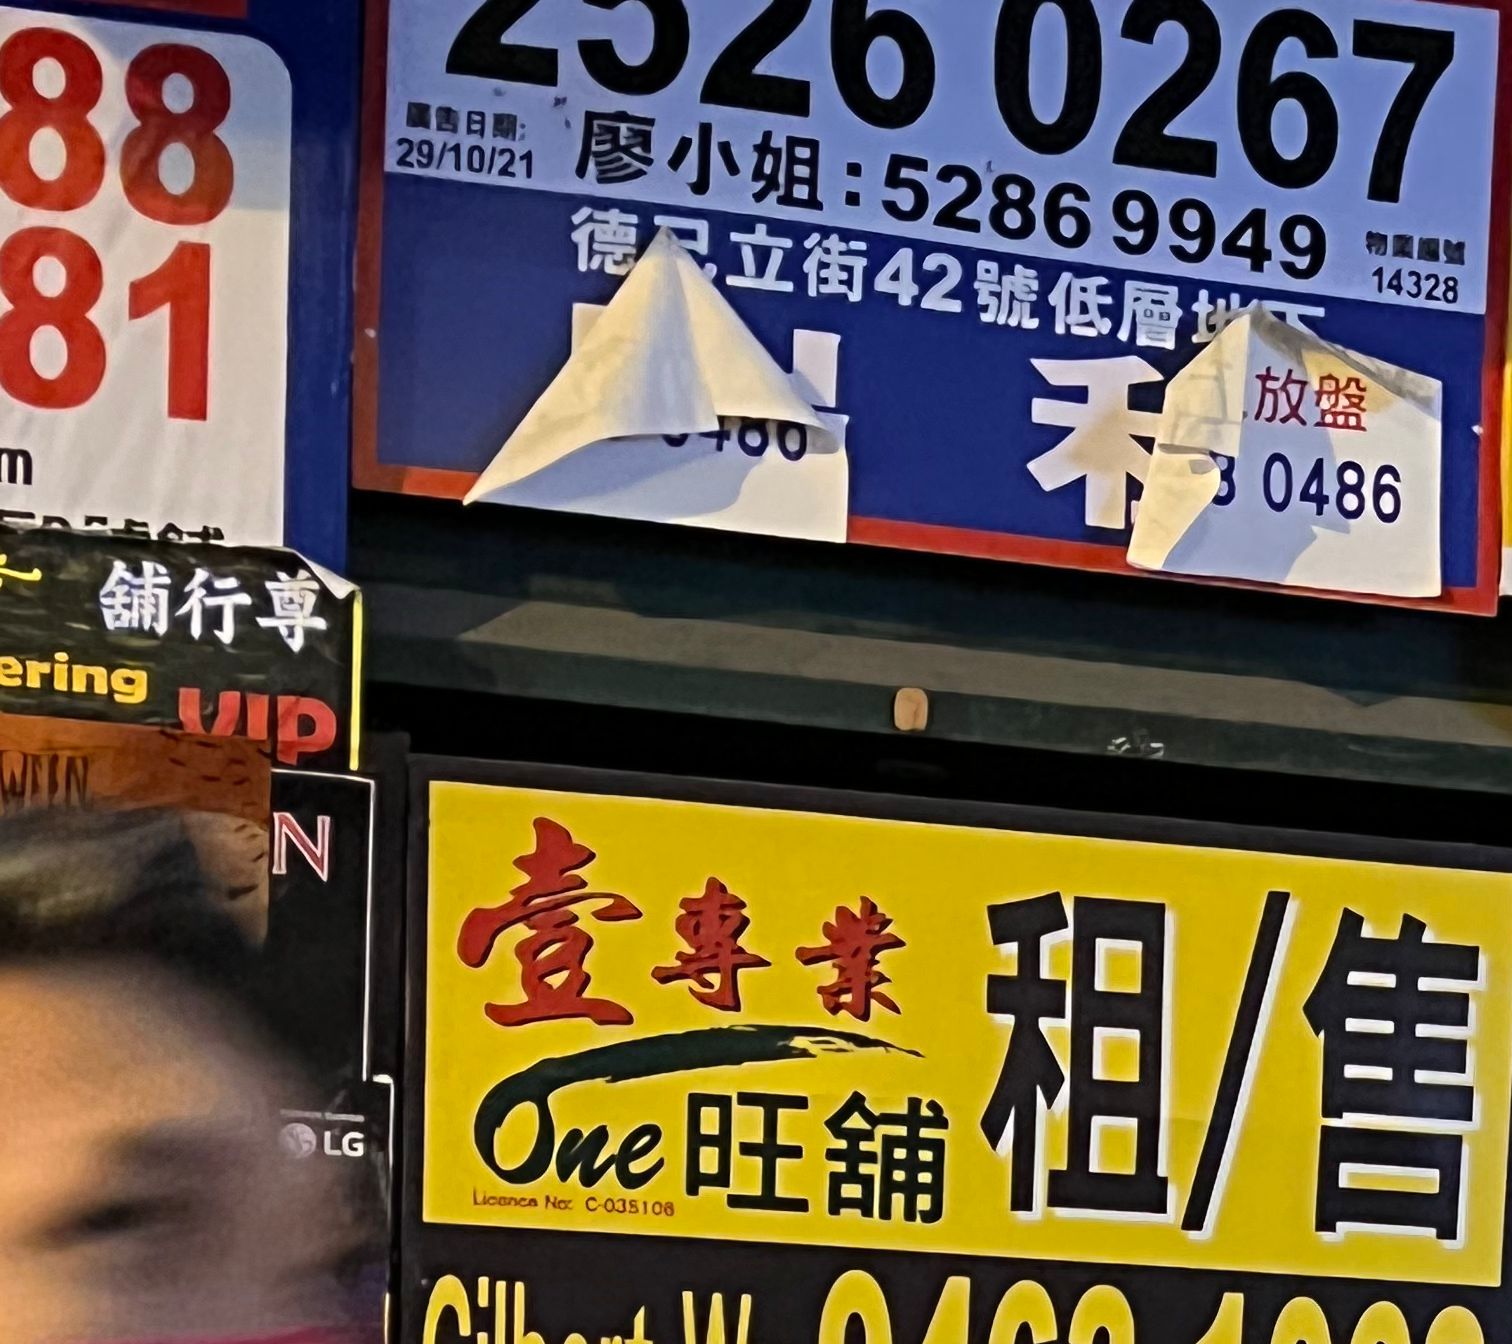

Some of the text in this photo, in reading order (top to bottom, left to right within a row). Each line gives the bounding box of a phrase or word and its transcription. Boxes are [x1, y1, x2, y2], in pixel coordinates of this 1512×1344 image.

[0, 26, 235, 226] 88
[994, 0, 1456, 204] 0267
[396, 137, 533, 179] 29/10/21
[1111, 190, 1327, 279] 9949
[0, 226, 212, 422] 81
[1372, 266, 1459, 304] 14328
[1254, 366, 1368, 433] 放盤
[1262, 452, 1402, 524] 0486
[178, 687, 338, 765] VIP
[457, 816, 907, 1027] 壹專業
[979, 889, 1484, 1247] 租/售
[323, 1129, 365, 1157] LG
[685, 1090, 951, 1224] 旺舖
